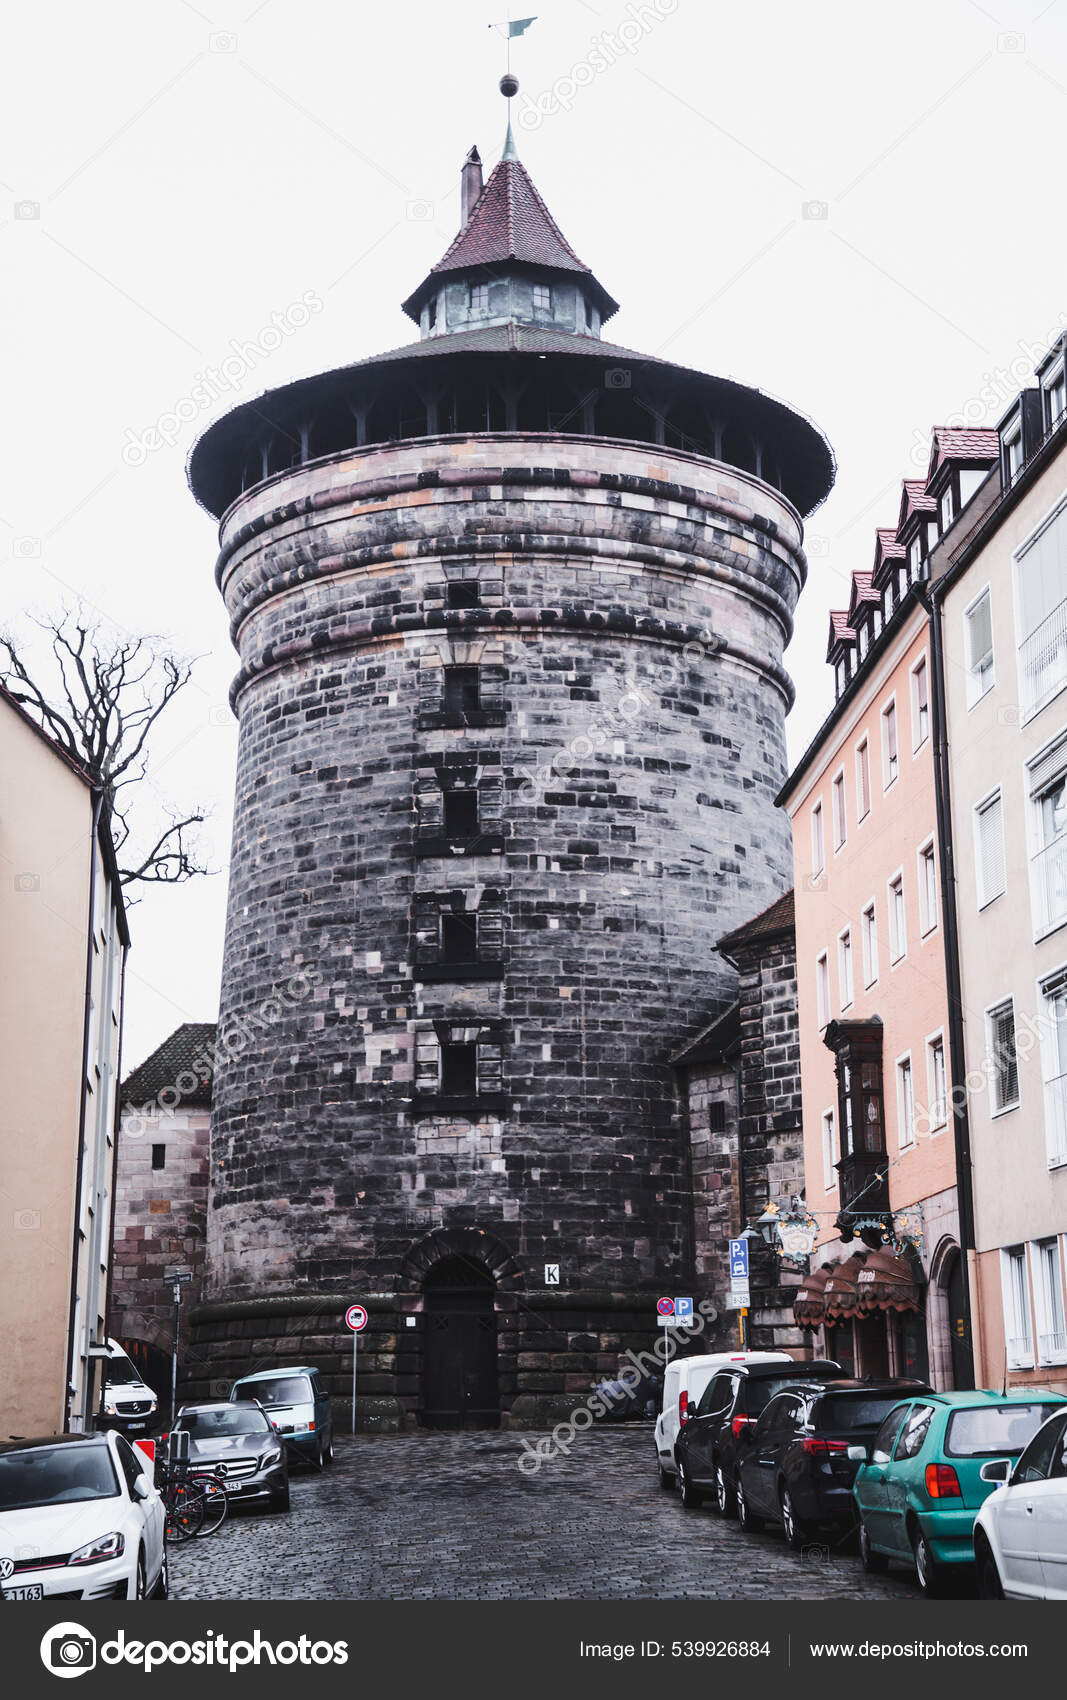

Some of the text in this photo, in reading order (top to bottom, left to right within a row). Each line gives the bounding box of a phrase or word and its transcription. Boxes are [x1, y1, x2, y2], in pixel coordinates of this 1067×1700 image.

[731, 1242, 741, 1258] P
[547, 1266, 557, 1282] K
[678, 1299, 689, 1314] P
